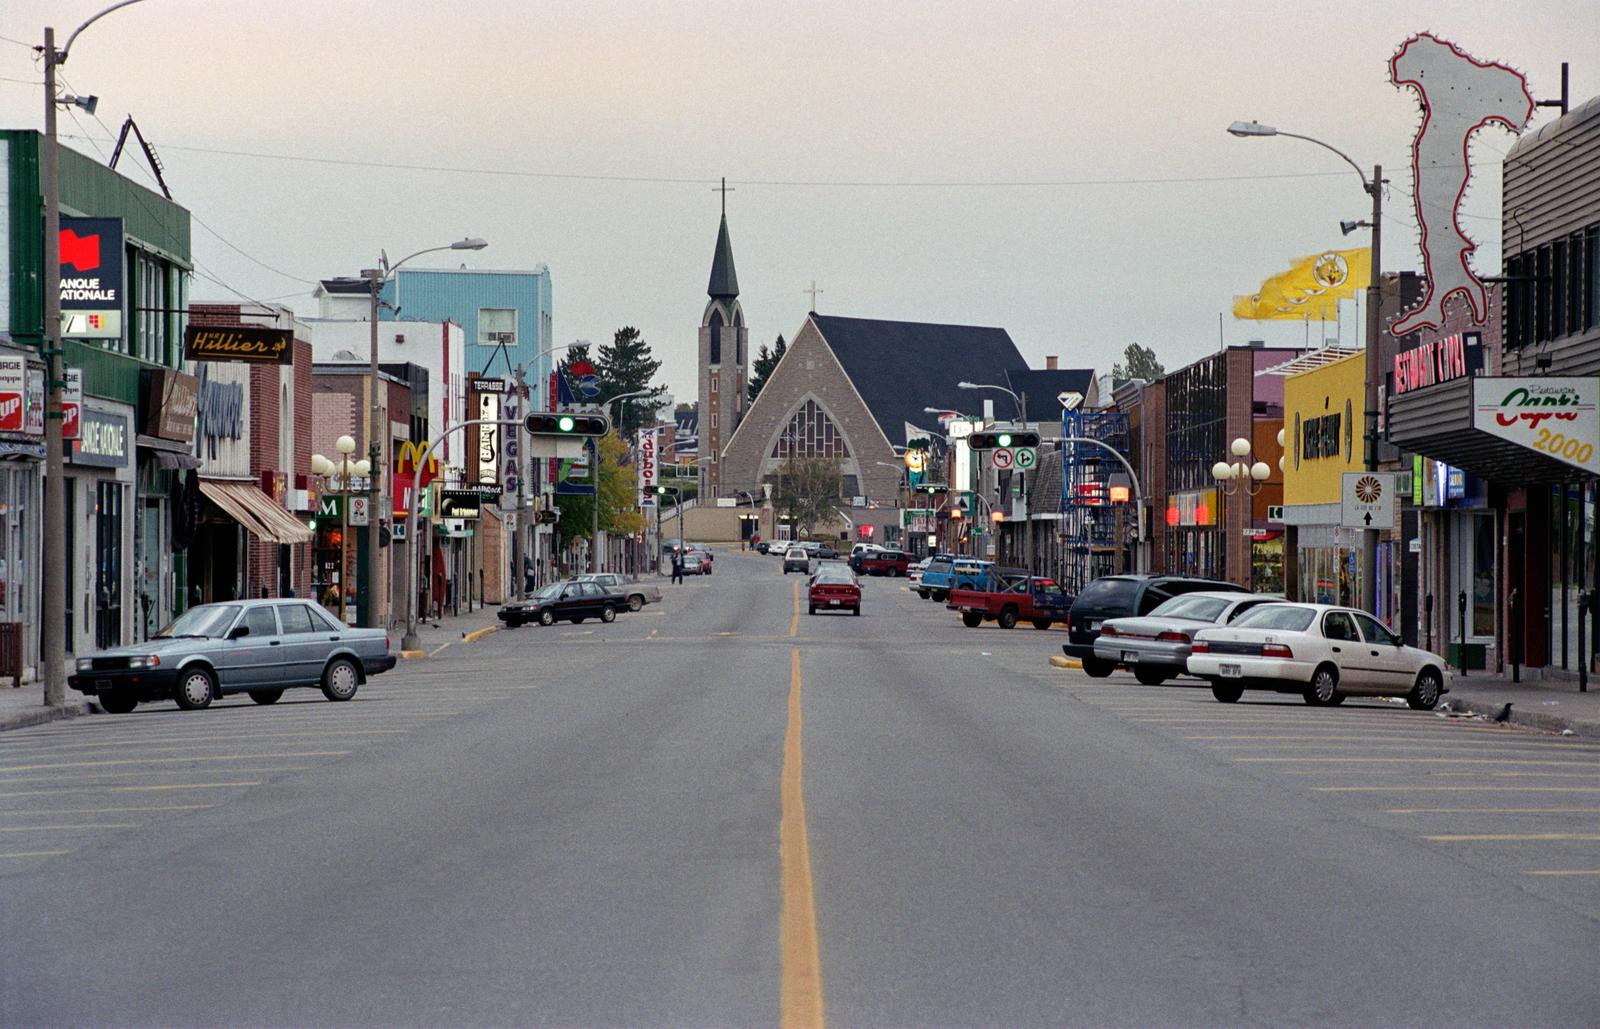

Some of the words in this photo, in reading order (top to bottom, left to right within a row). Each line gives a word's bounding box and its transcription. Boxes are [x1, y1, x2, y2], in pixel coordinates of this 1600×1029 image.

[60, 278, 99, 289] ANQUE
[60, 290, 115, 300] ATIONALE
[192, 332, 268, 352] Hillier
[474, 381, 503, 391] TERRASSE
[1529, 384, 1576, 395] Restaurant
[504, 405, 518, 493] VEGAS
[1532, 427, 1593, 464] 2000
